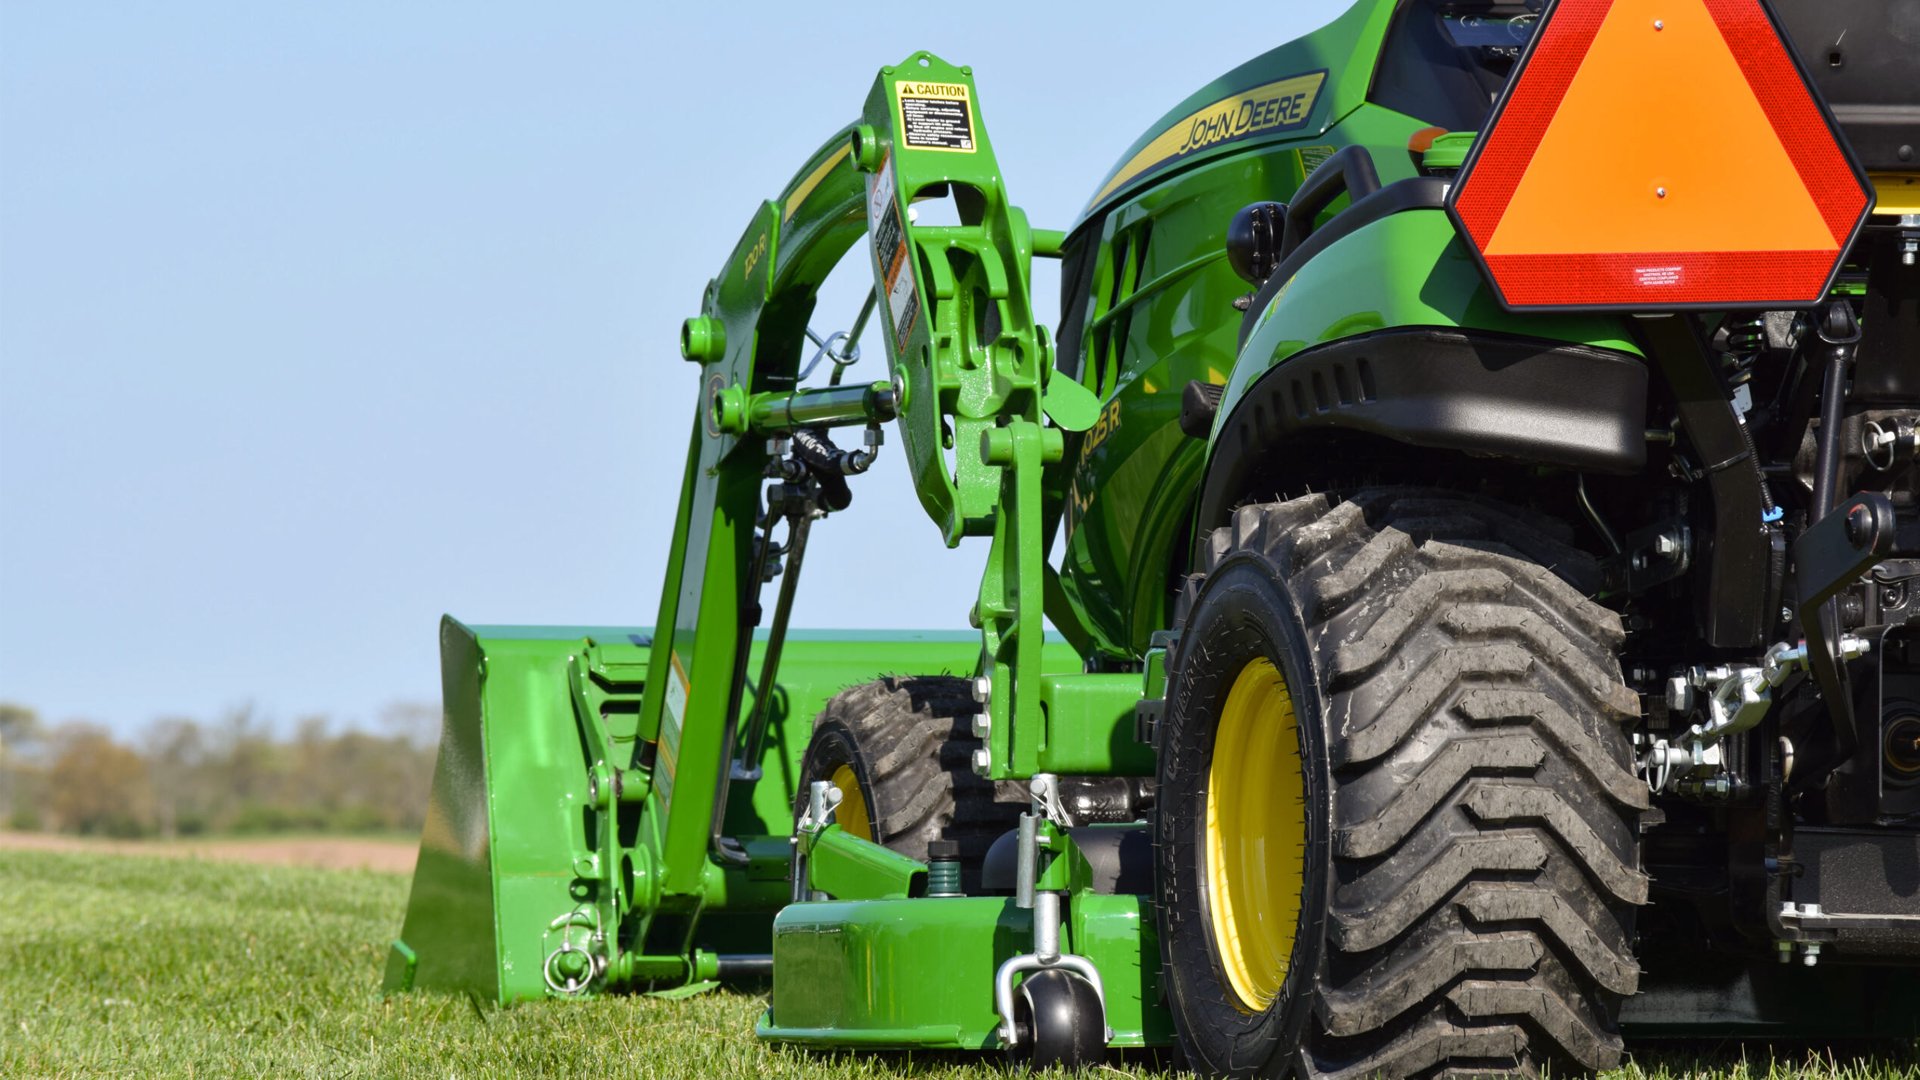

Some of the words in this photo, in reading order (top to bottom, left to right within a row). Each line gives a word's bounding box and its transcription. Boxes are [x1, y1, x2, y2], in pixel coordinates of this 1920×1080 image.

[917, 84, 965, 97] CAUTION
[1180, 109, 1235, 151] JOHN
[1236, 93, 1306, 130] DEERE
